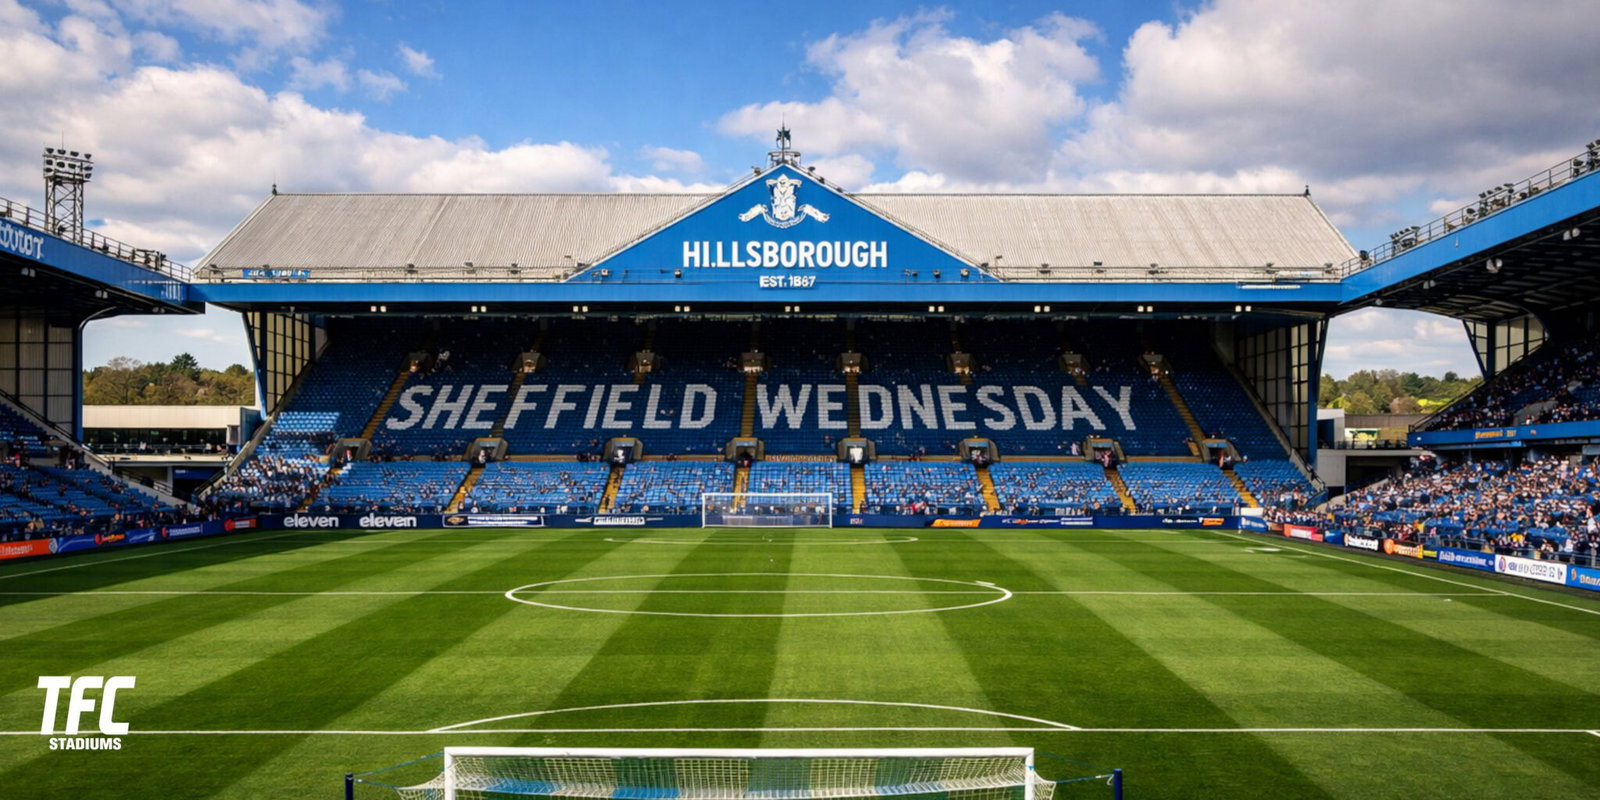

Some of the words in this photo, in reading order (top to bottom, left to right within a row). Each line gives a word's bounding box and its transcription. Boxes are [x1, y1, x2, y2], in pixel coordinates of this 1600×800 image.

[386, 384, 716, 430] SHEFFIELD
[757, 384, 1136, 429] WEDNESDAY
[283, 514, 338, 528] eleven
